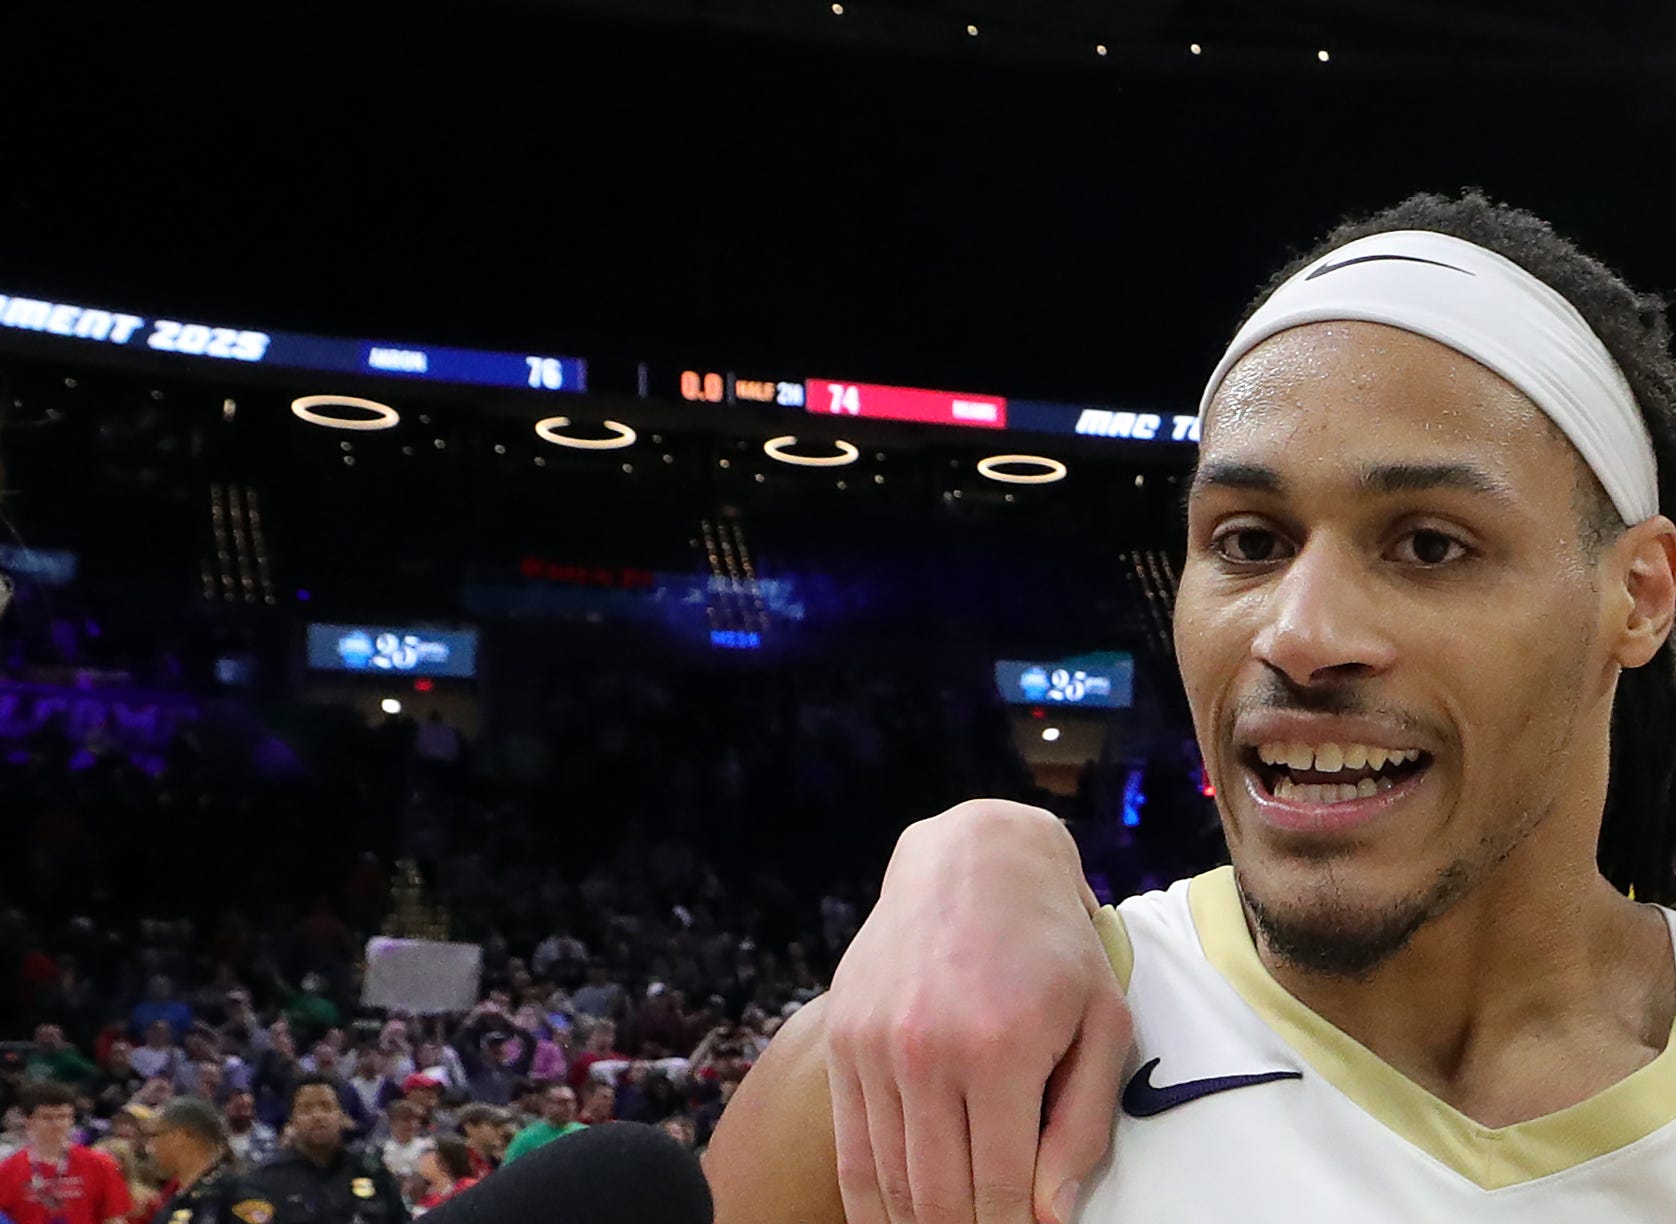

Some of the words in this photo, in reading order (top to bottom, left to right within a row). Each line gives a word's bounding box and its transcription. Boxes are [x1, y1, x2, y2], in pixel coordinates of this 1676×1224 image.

[0, 294, 144, 344] MENT
[147, 319, 271, 362] 2025
[525, 356, 563, 390] 76
[828, 383, 860, 415] 74
[1075, 409, 1161, 440] MAC
